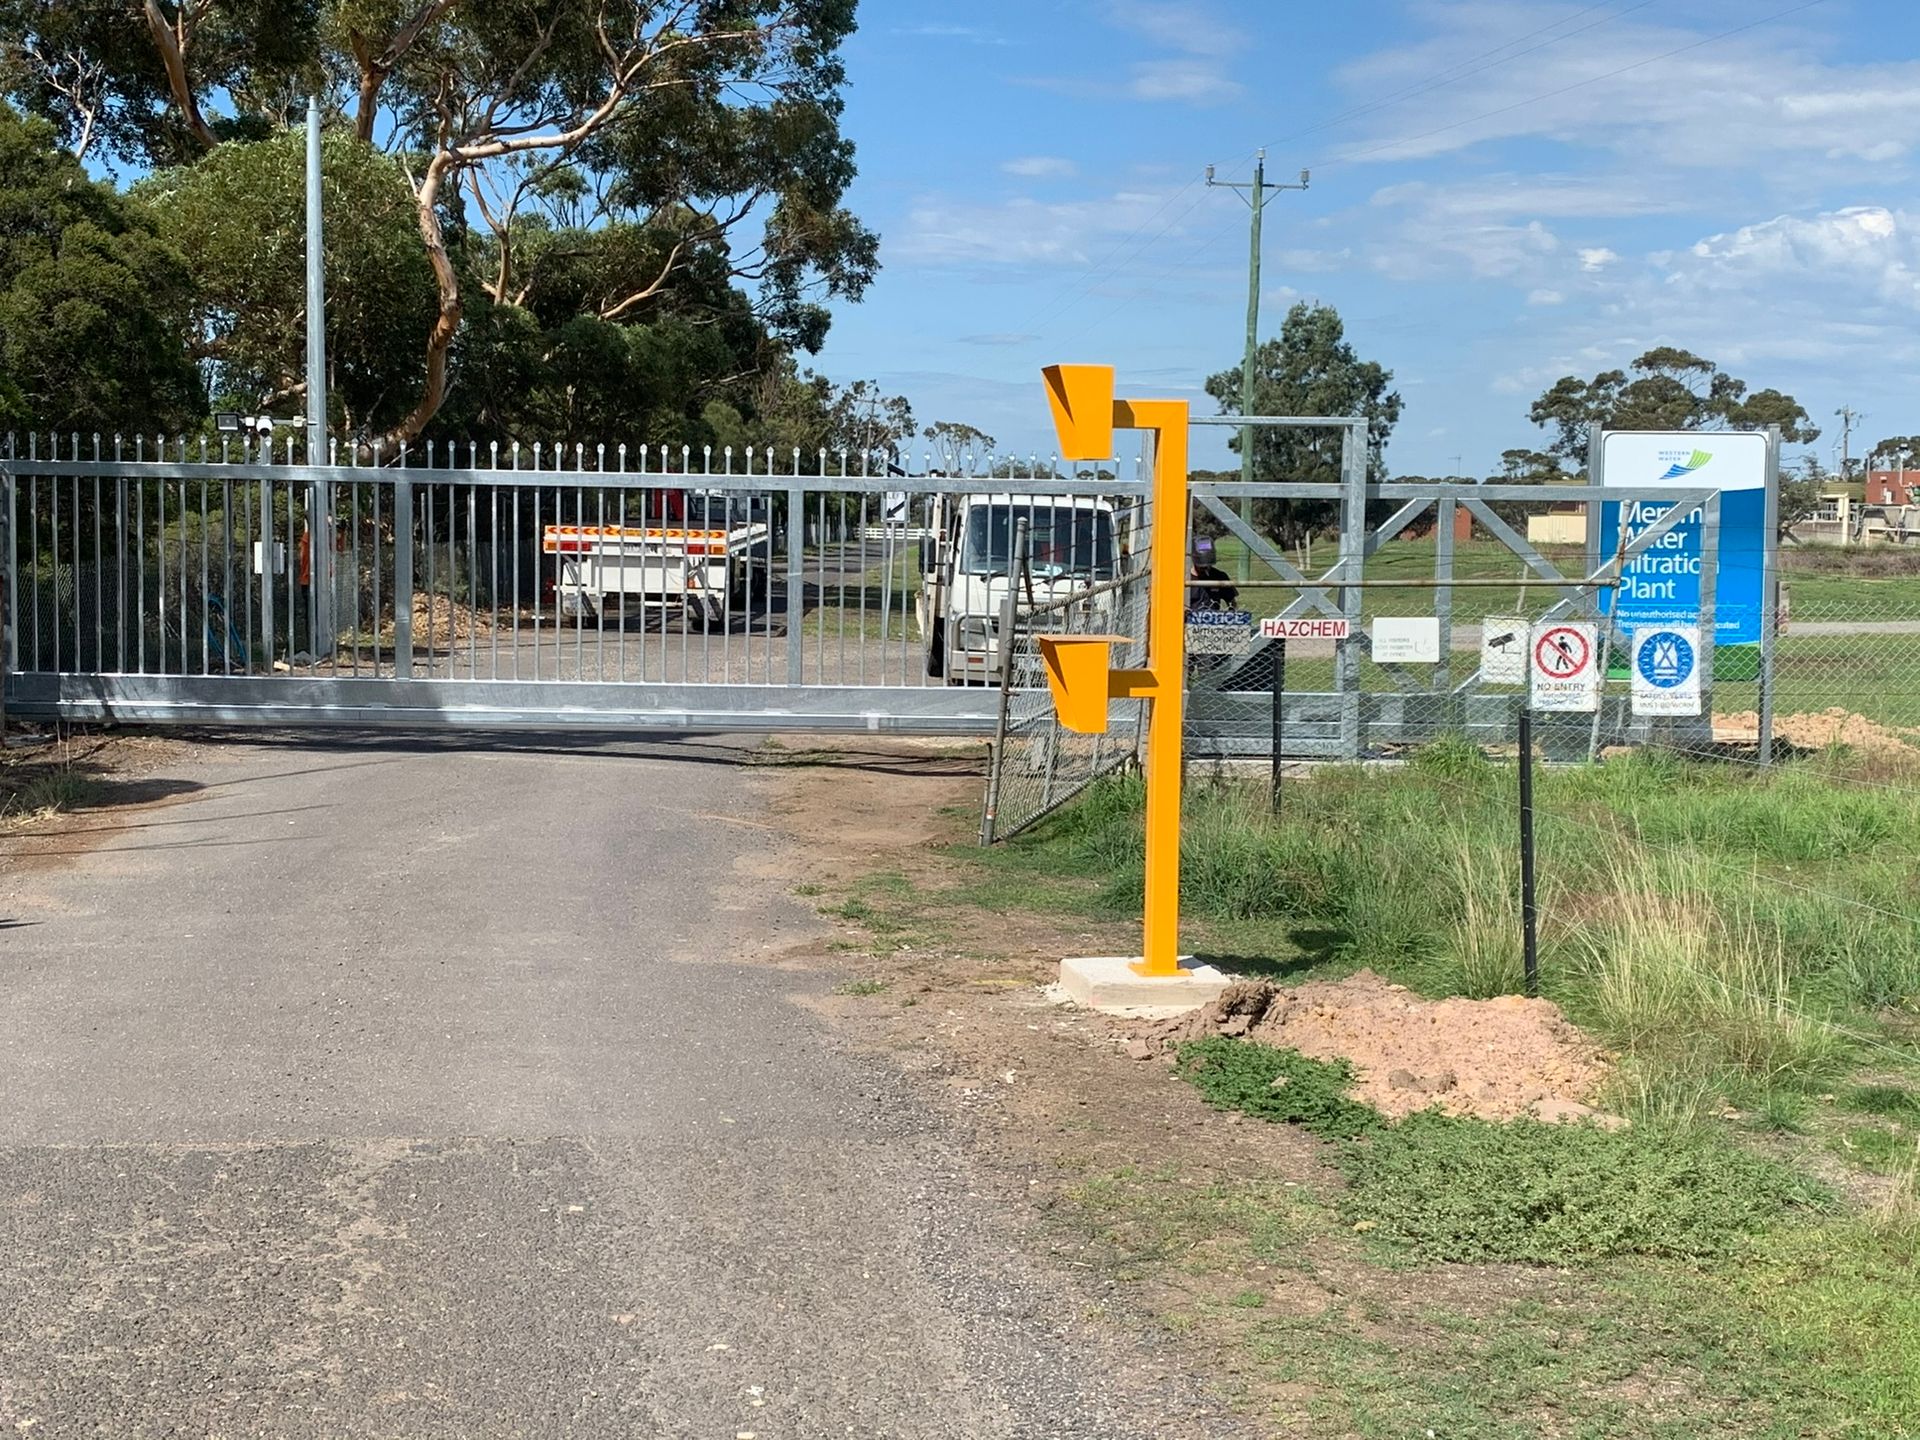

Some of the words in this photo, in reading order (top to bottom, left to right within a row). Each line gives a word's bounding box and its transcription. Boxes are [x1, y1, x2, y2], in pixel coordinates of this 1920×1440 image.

[1618, 576, 1676, 599] Plant
[1191, 611, 1245, 624] NOTICE
[1617, 610, 1629, 618] No
[1264, 621, 1346, 636] HAZCHEM
[1537, 682, 1551, 691] NO
[1554, 682, 1585, 692] ENTRY
